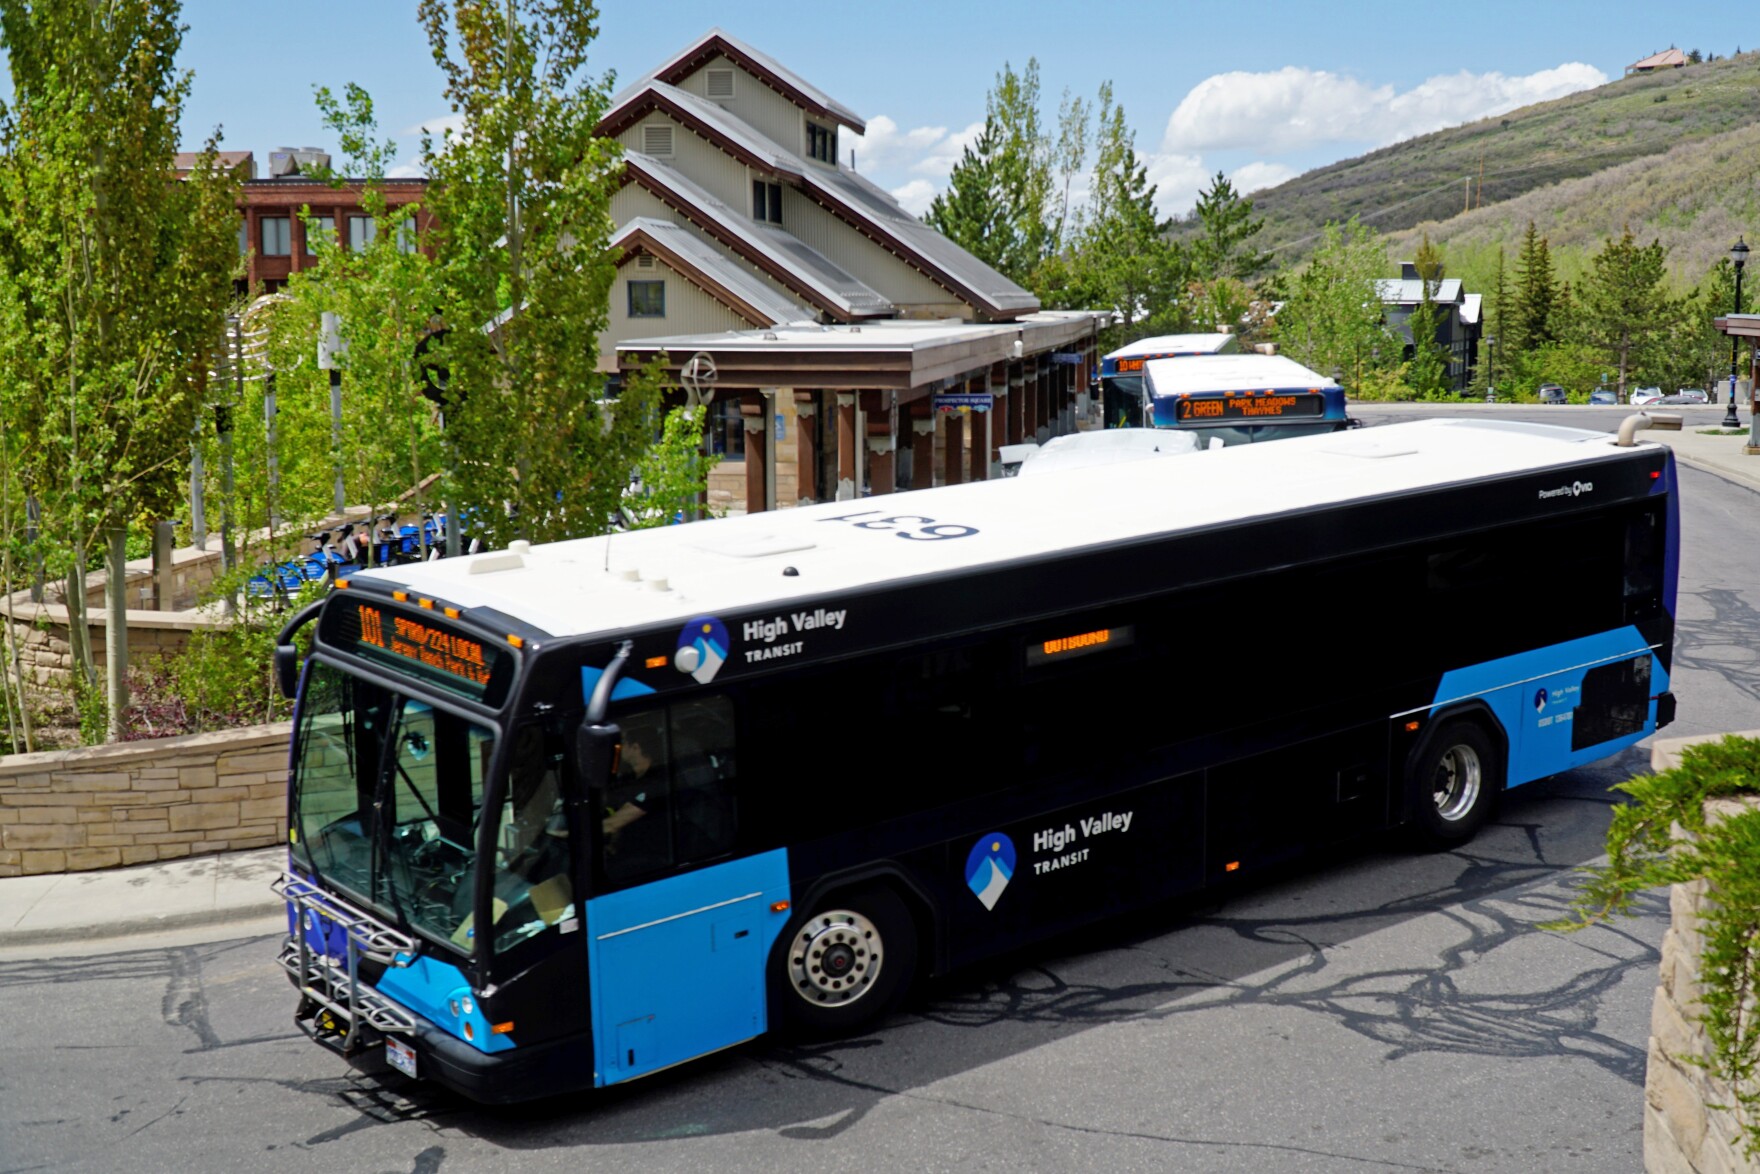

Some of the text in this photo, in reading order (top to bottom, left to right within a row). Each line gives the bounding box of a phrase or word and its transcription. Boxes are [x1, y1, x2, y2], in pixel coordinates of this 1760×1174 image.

[1119, 360, 1128, 372] 10
[1182, 400, 1224, 419] 2 GREEN
[1228, 396, 1297, 409] PARK MEADOWS
[1538, 485, 1564, 499] Powered
[1564, 485, 1572, 497] by
[358, 604, 385, 648] 101
[743, 609, 847, 642] High Valley
[451, 635, 486, 667] LOCAL
[745, 641, 804, 663] TRANSIT
[1044, 629, 1109, 655] OUTBOUND
[1033, 811, 1134, 852] High Valley
[1033, 848, 1090, 875] TRANSIT
